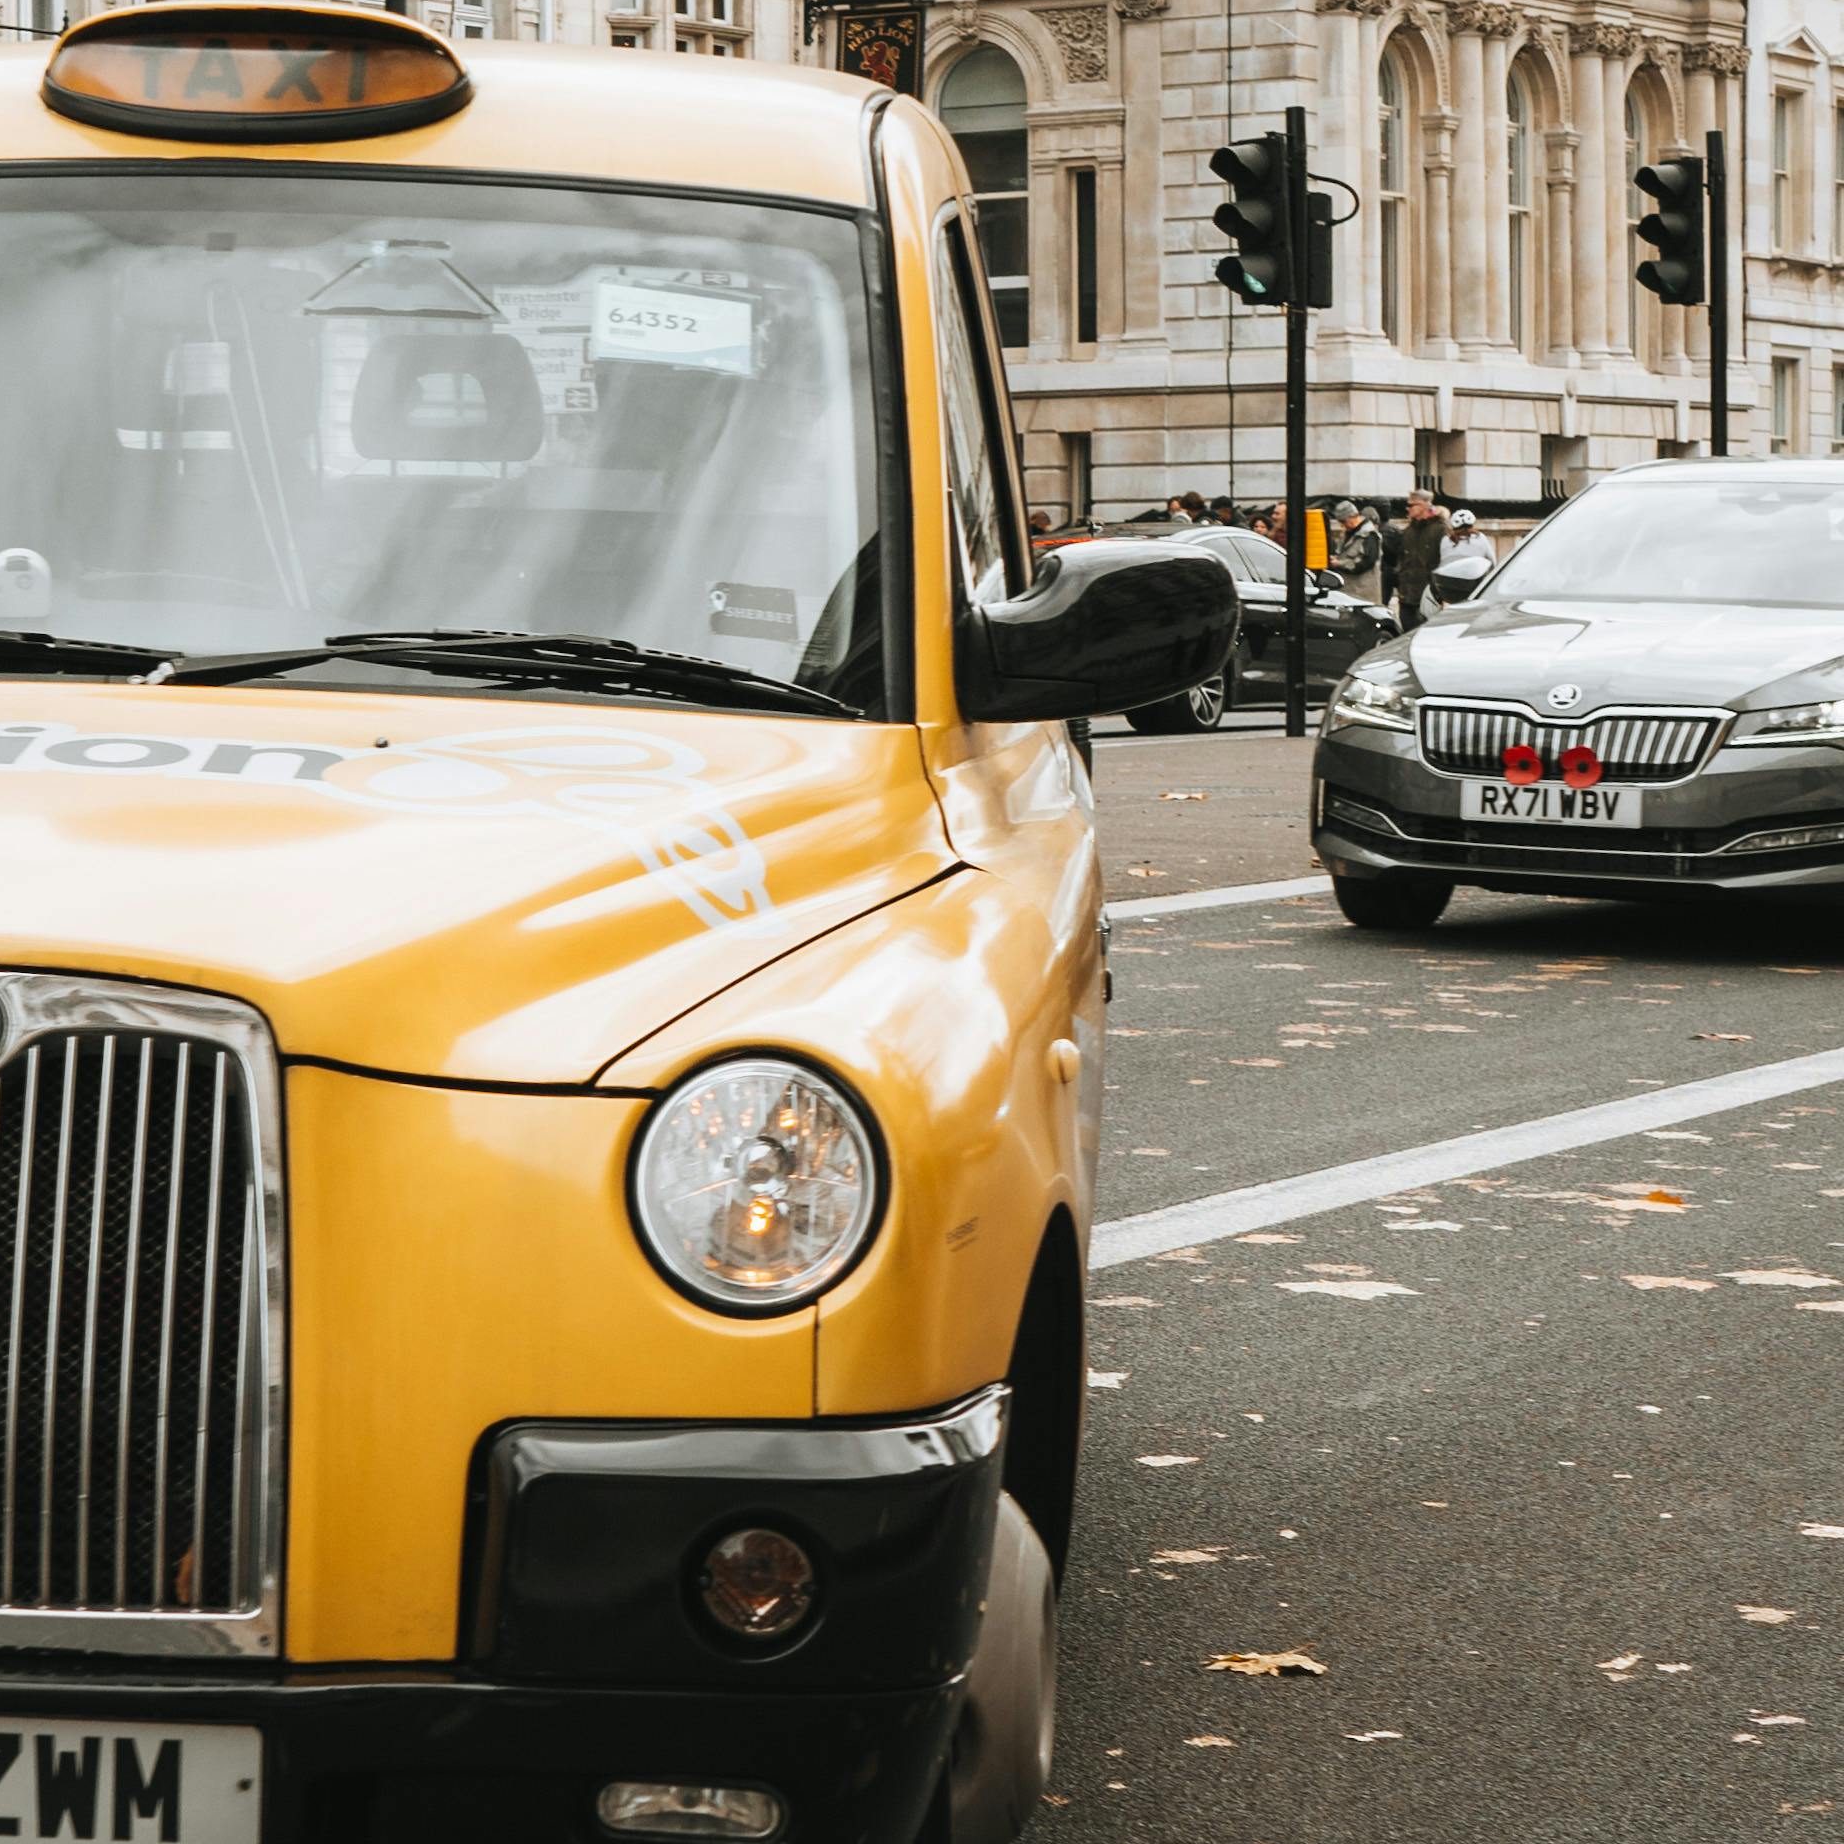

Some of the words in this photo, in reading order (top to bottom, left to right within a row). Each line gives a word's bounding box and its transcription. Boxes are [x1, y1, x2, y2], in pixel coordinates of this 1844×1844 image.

[847, 29, 876, 51] RED
[878, 27, 913, 46] LION
[133, 38, 370, 103] TAXI
[608, 307, 698, 333] 64352
[1480, 785, 1549, 818] RX71
[1559, 789, 1620, 821] WBV
